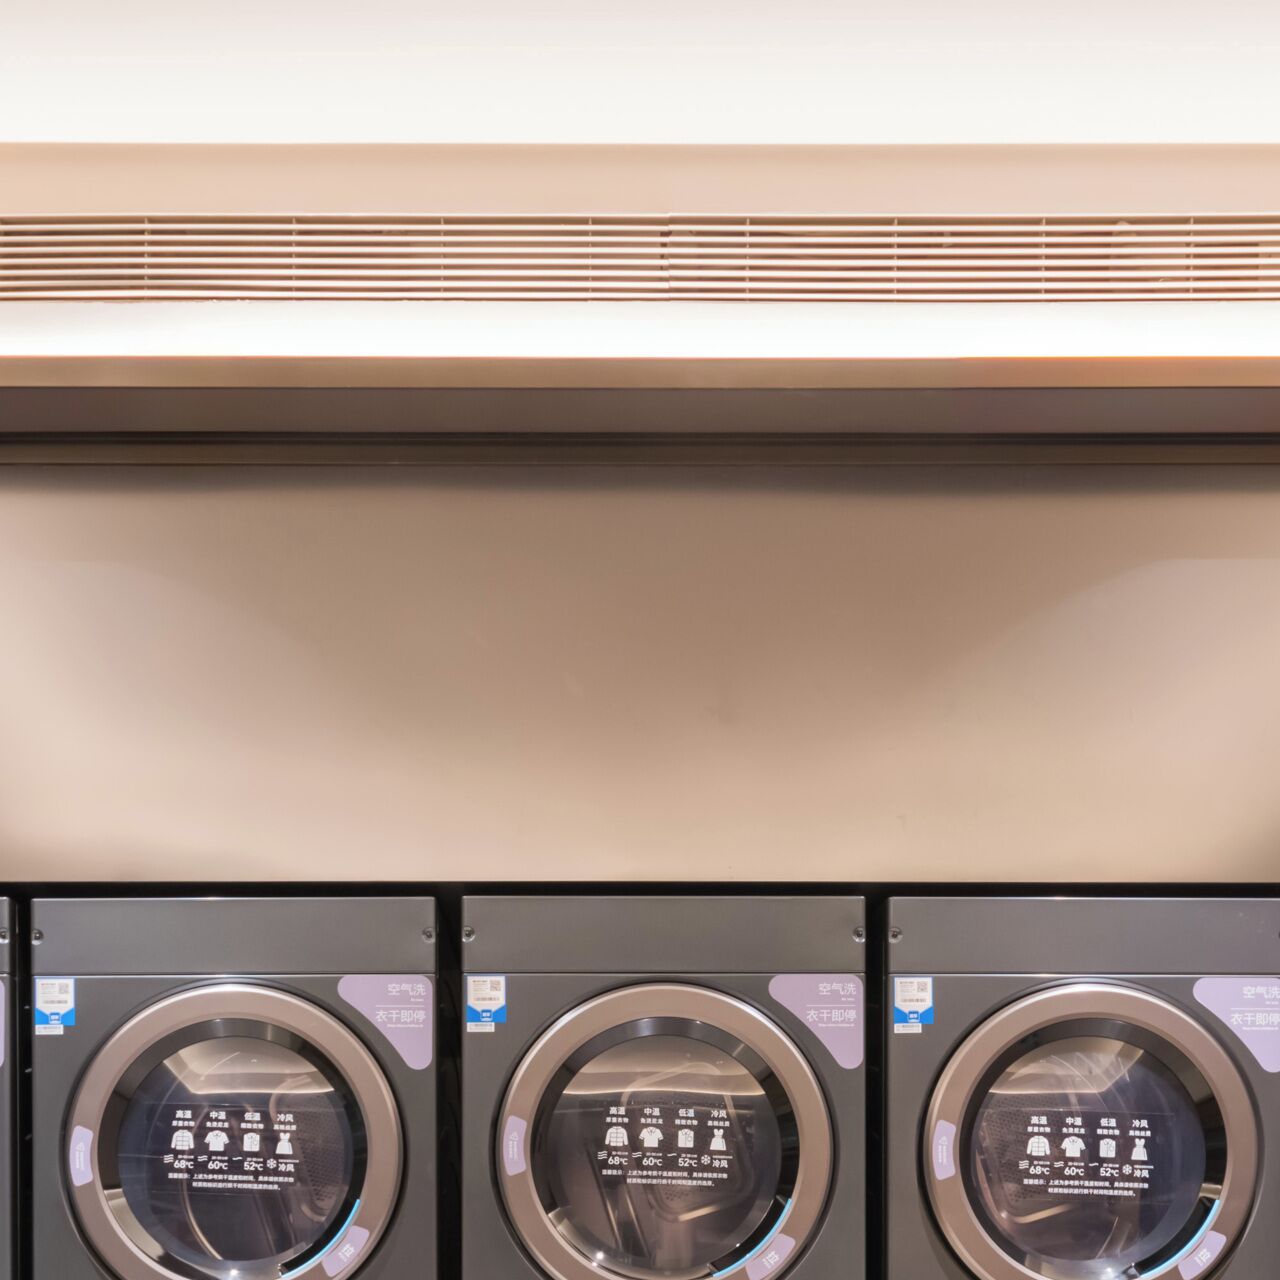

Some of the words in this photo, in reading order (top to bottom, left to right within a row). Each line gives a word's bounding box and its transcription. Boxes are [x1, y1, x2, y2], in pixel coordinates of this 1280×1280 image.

[388, 983, 426, 995] 空气洗
[819, 983, 856, 995] 空气洗
[1243, 986, 1280, 998] 空气洗
[376, 1010, 425, 1022] 衣干即停
[807, 1009, 856, 1022] 衣干即停
[1231, 1012, 1280, 1025] 衣干即停
[175, 1111, 192, 1119] 高温
[609, 1107, 626, 1115] 高温
[644, 1108, 660, 1116] 中温
[679, 1109, 694, 1117] 低温
[711, 1110, 727, 1118] 冷风
[245, 1112, 260, 1120] 低温
[277, 1113, 294, 1122] 冷风
[1031, 1116, 1047, 1124] 高温
[1066, 1117, 1082, 1125] 中温
[1100, 1119, 1116, 1127] 低温
[1132, 1120, 1148, 1128] 冷风
[1134, 1169, 1149, 1177] 冷风
